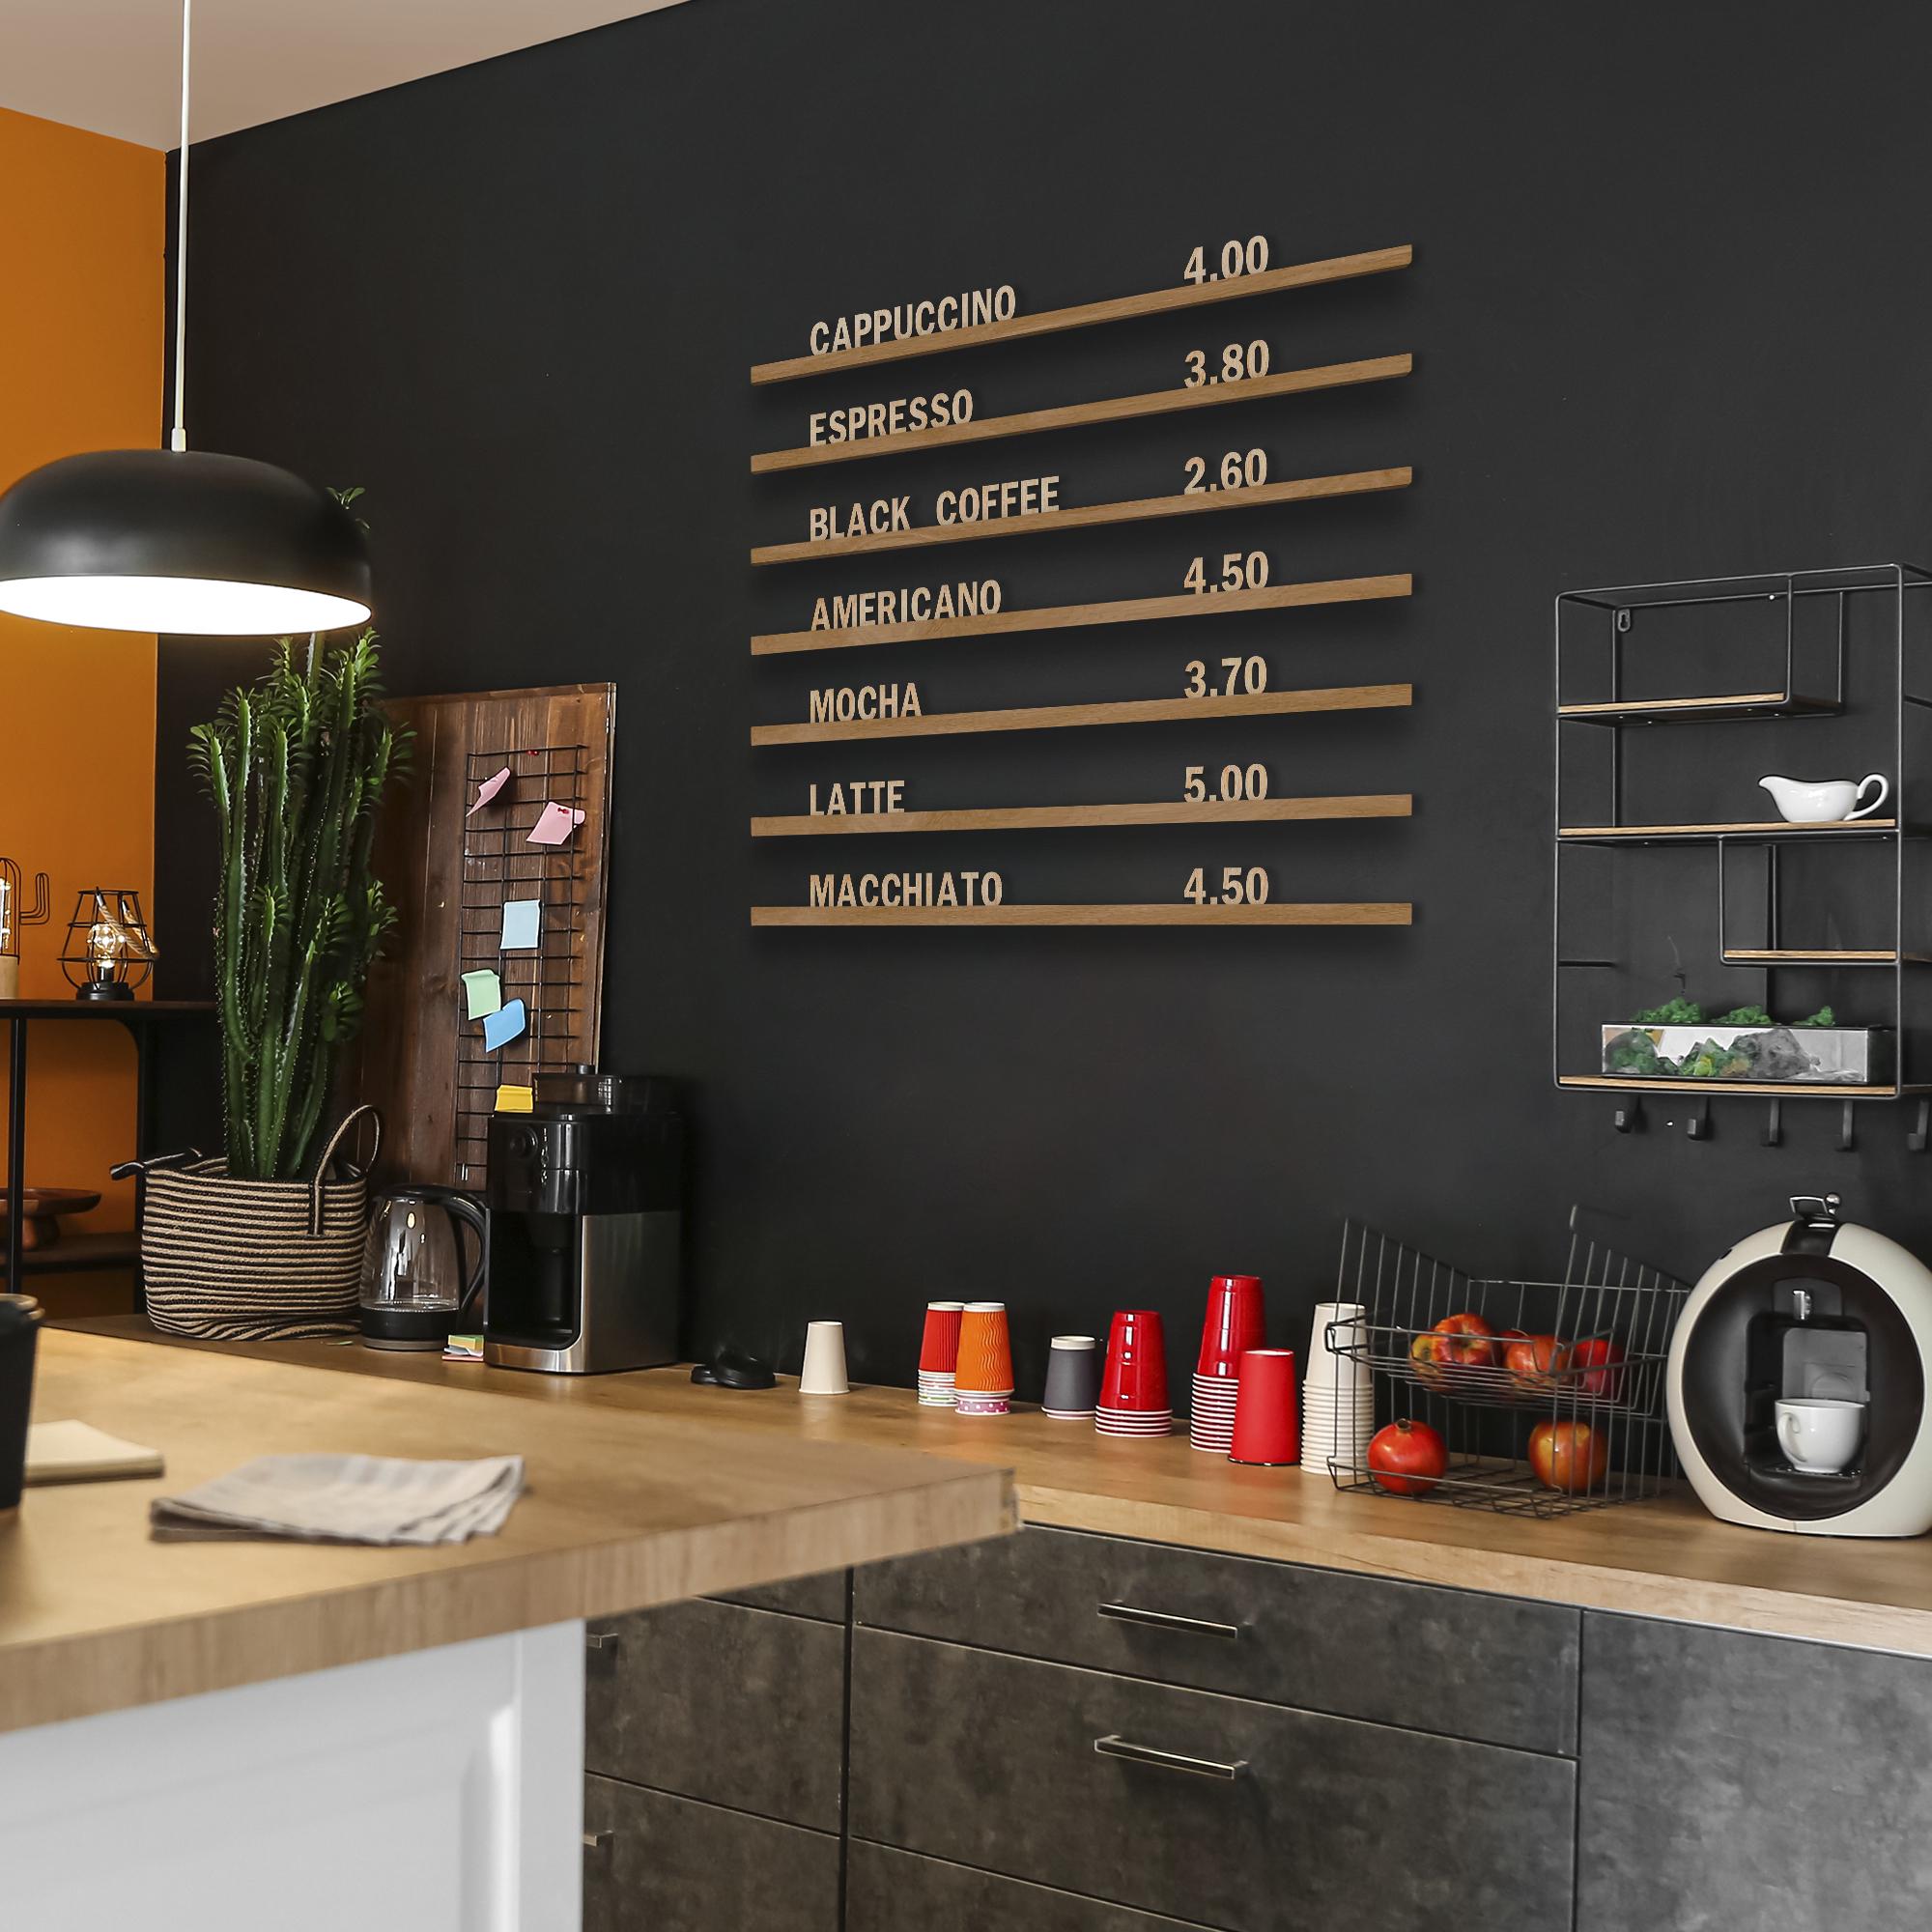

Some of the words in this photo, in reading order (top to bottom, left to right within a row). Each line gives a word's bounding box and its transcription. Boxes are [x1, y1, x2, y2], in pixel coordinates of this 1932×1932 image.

[810, 285, 1016, 355] CAPPUCCINO
[1183, 235, 1269, 285] 4.00
[810, 388, 974, 446] ESPRESSO
[1183, 339, 1270, 388] 3.80
[810, 496, 912, 541] BLACK
[936, 475, 1060, 526] COFFEE
[1183, 447, 1268, 495] 2.60
[810, 580, 1002, 631] AMERICANO
[1183, 551, 1269, 594] 4.50
[810, 682, 923, 723] MOCHA
[1183, 655, 1268, 697] 3.70
[810, 780, 906, 816] LATTE
[1183, 763, 1269, 803] 5.00
[810, 871, 1003, 907] MACCHIATO
[1183, 867, 1269, 905] 4.50
